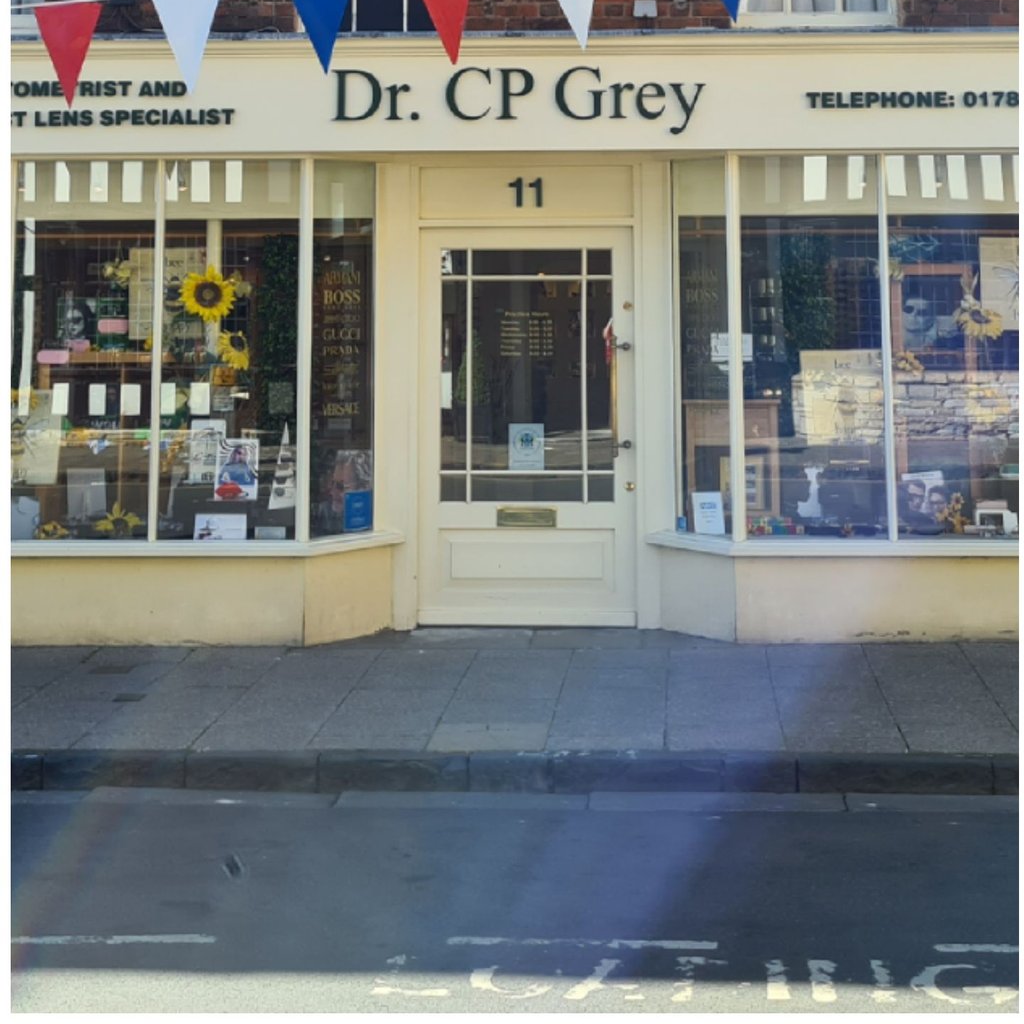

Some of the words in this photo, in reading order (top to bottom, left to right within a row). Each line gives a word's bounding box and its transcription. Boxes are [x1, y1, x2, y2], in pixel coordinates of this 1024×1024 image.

[11, 80, 132, 98] OMERIST
[139, 80, 187, 97] AND
[331, 68, 420, 122] Dr.
[445, 66, 535, 121] CP
[554, 65, 706, 136] Grey
[806, 91, 955, 109] TELEPHONE:
[962, 90, 1019, 108] 0178
[34, 110, 93, 127] LENS
[100, 108, 235, 126] SPECIALIST
[507, 177, 544, 208] 11
[323, 289, 361, 305] BOSS
